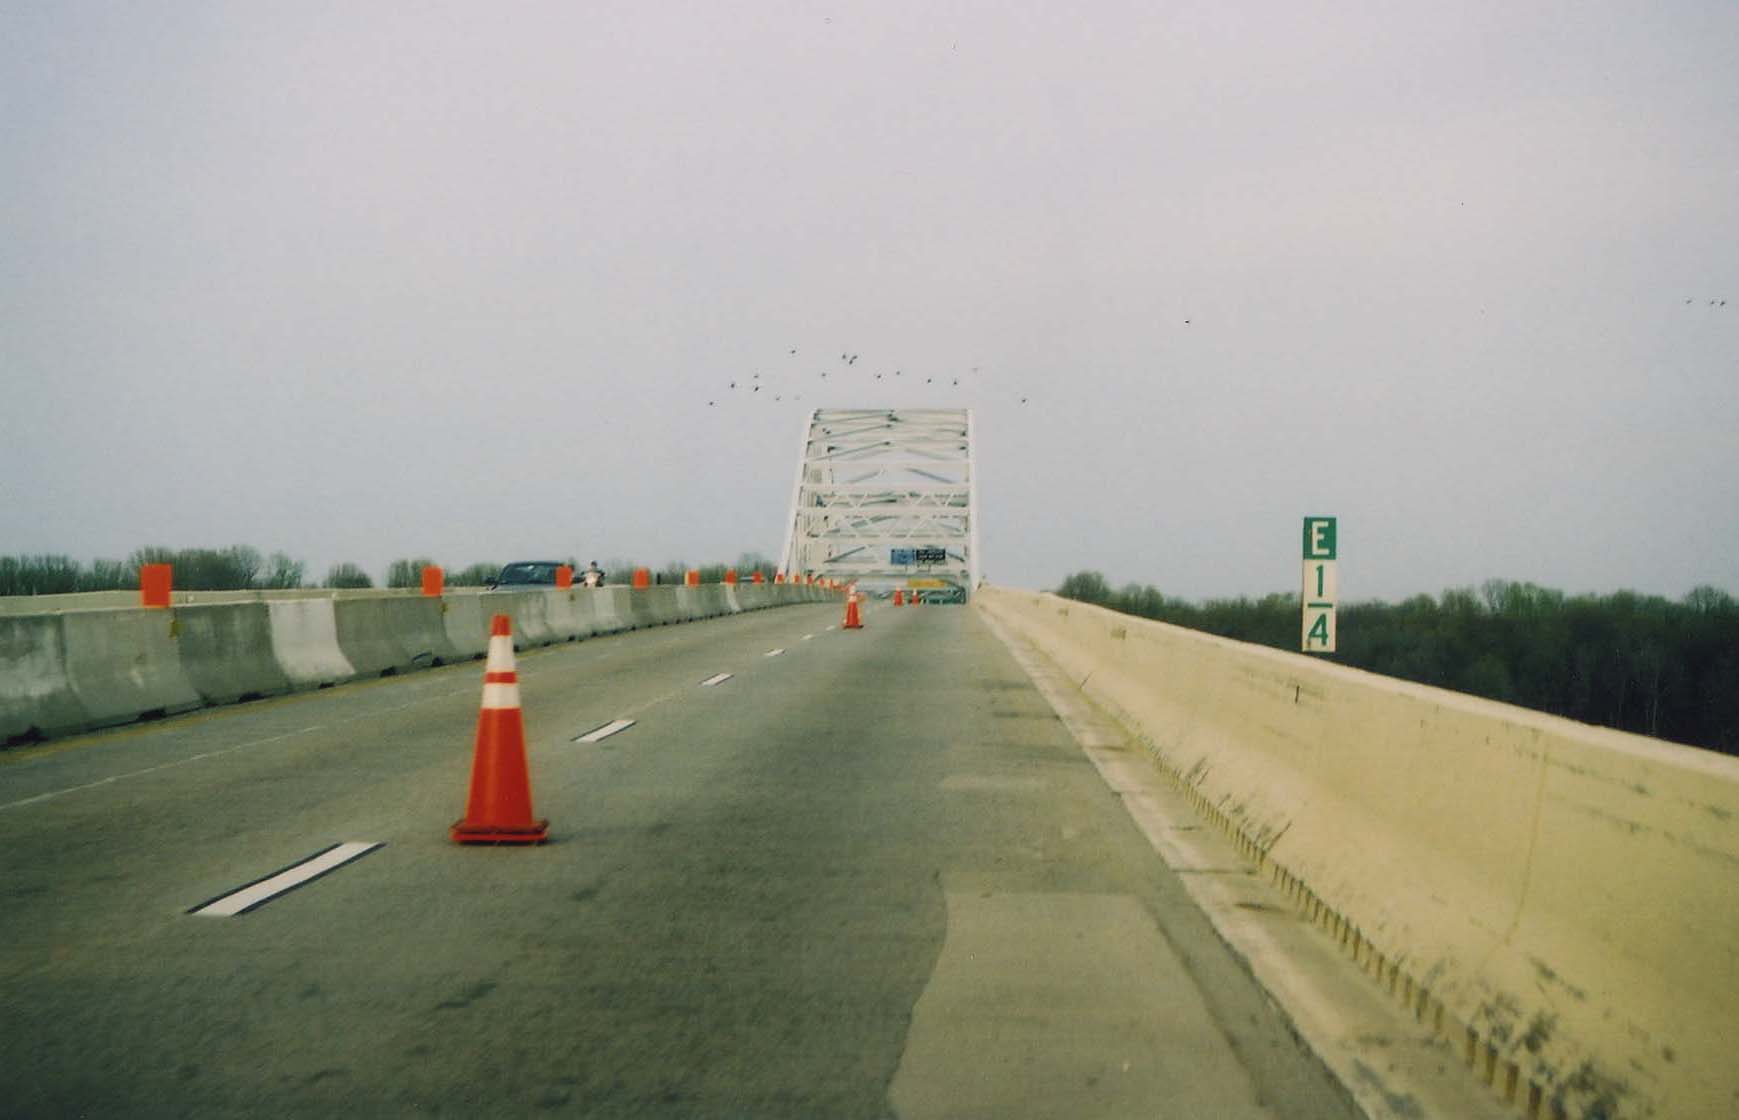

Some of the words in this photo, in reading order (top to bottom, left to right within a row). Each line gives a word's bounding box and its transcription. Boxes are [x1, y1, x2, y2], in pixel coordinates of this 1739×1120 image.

[1312, 521, 1329, 555] E
[1315, 564, 1324, 597] 1
[1308, 613, 1328, 646] 4
